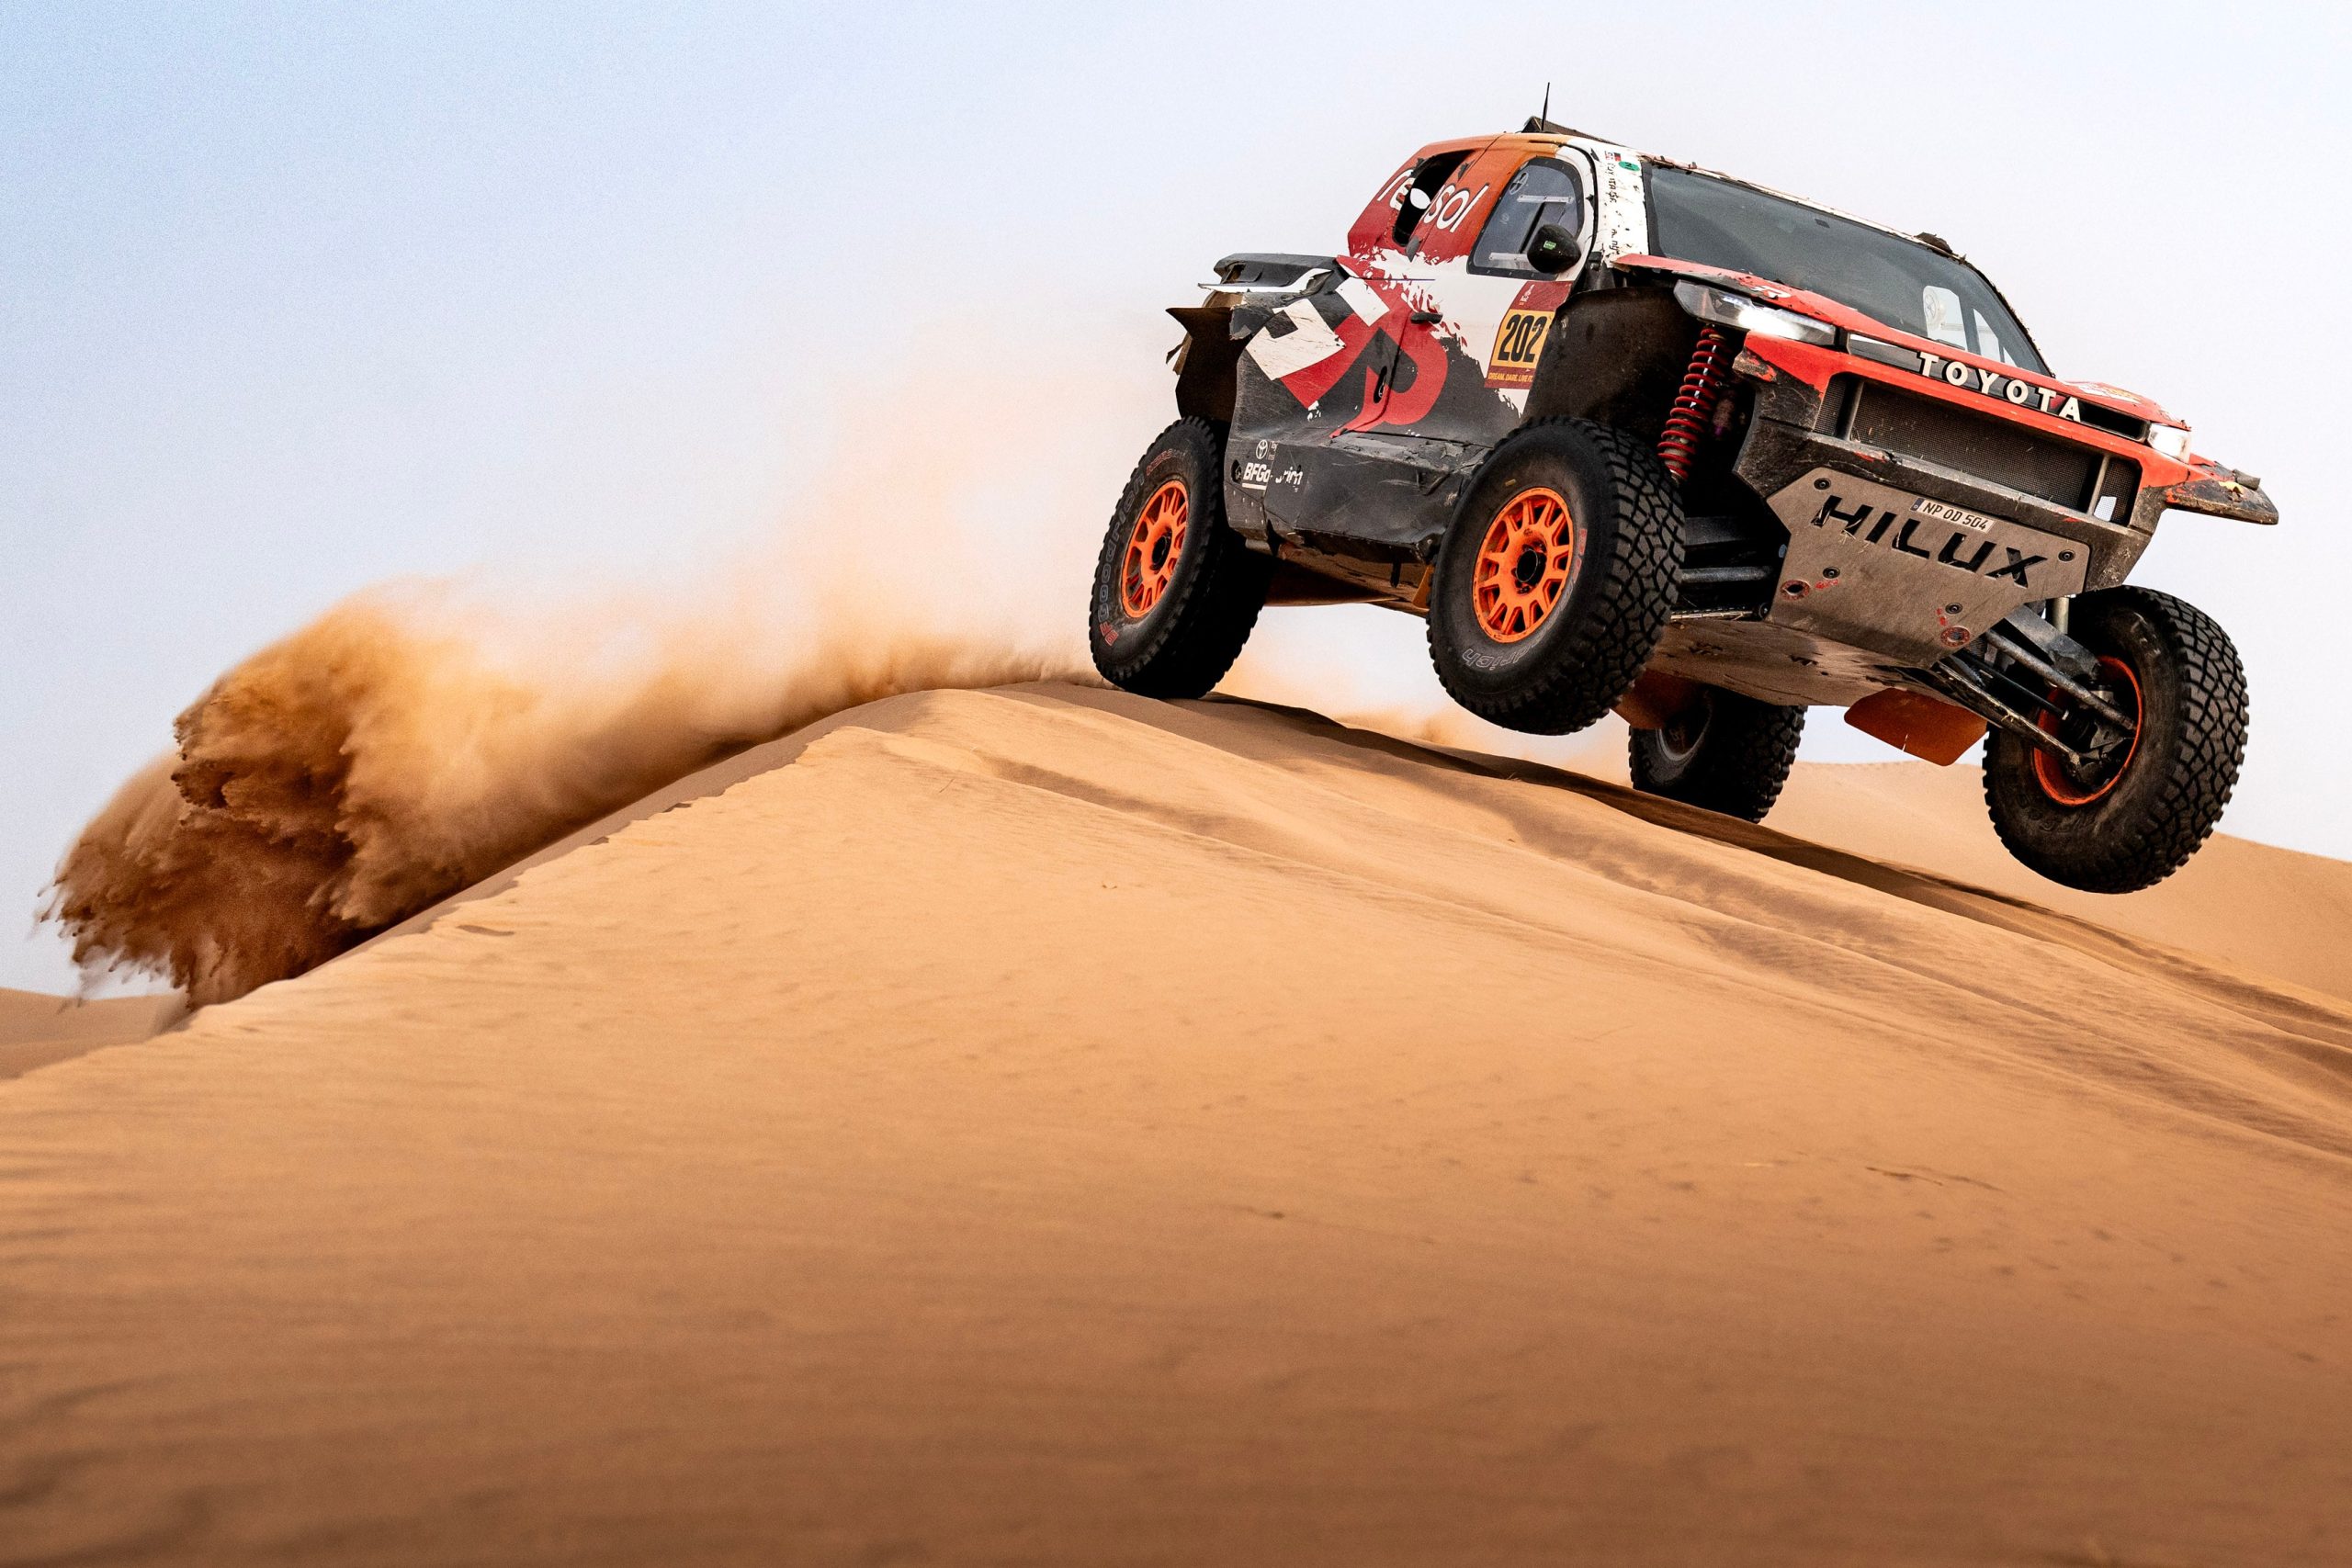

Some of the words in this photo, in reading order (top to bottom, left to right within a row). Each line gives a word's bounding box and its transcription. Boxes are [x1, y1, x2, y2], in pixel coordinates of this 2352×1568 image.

[1376, 169, 1489, 233] resol
[1498, 314, 1548, 363] 202
[1919, 352, 2081, 423] TOYOTA
[1810, 495, 2048, 588] HILUX
[1923, 502, 1943, 515] NP
[1943, 509, 1963, 522] OD
[1962, 514, 1988, 530] 504
